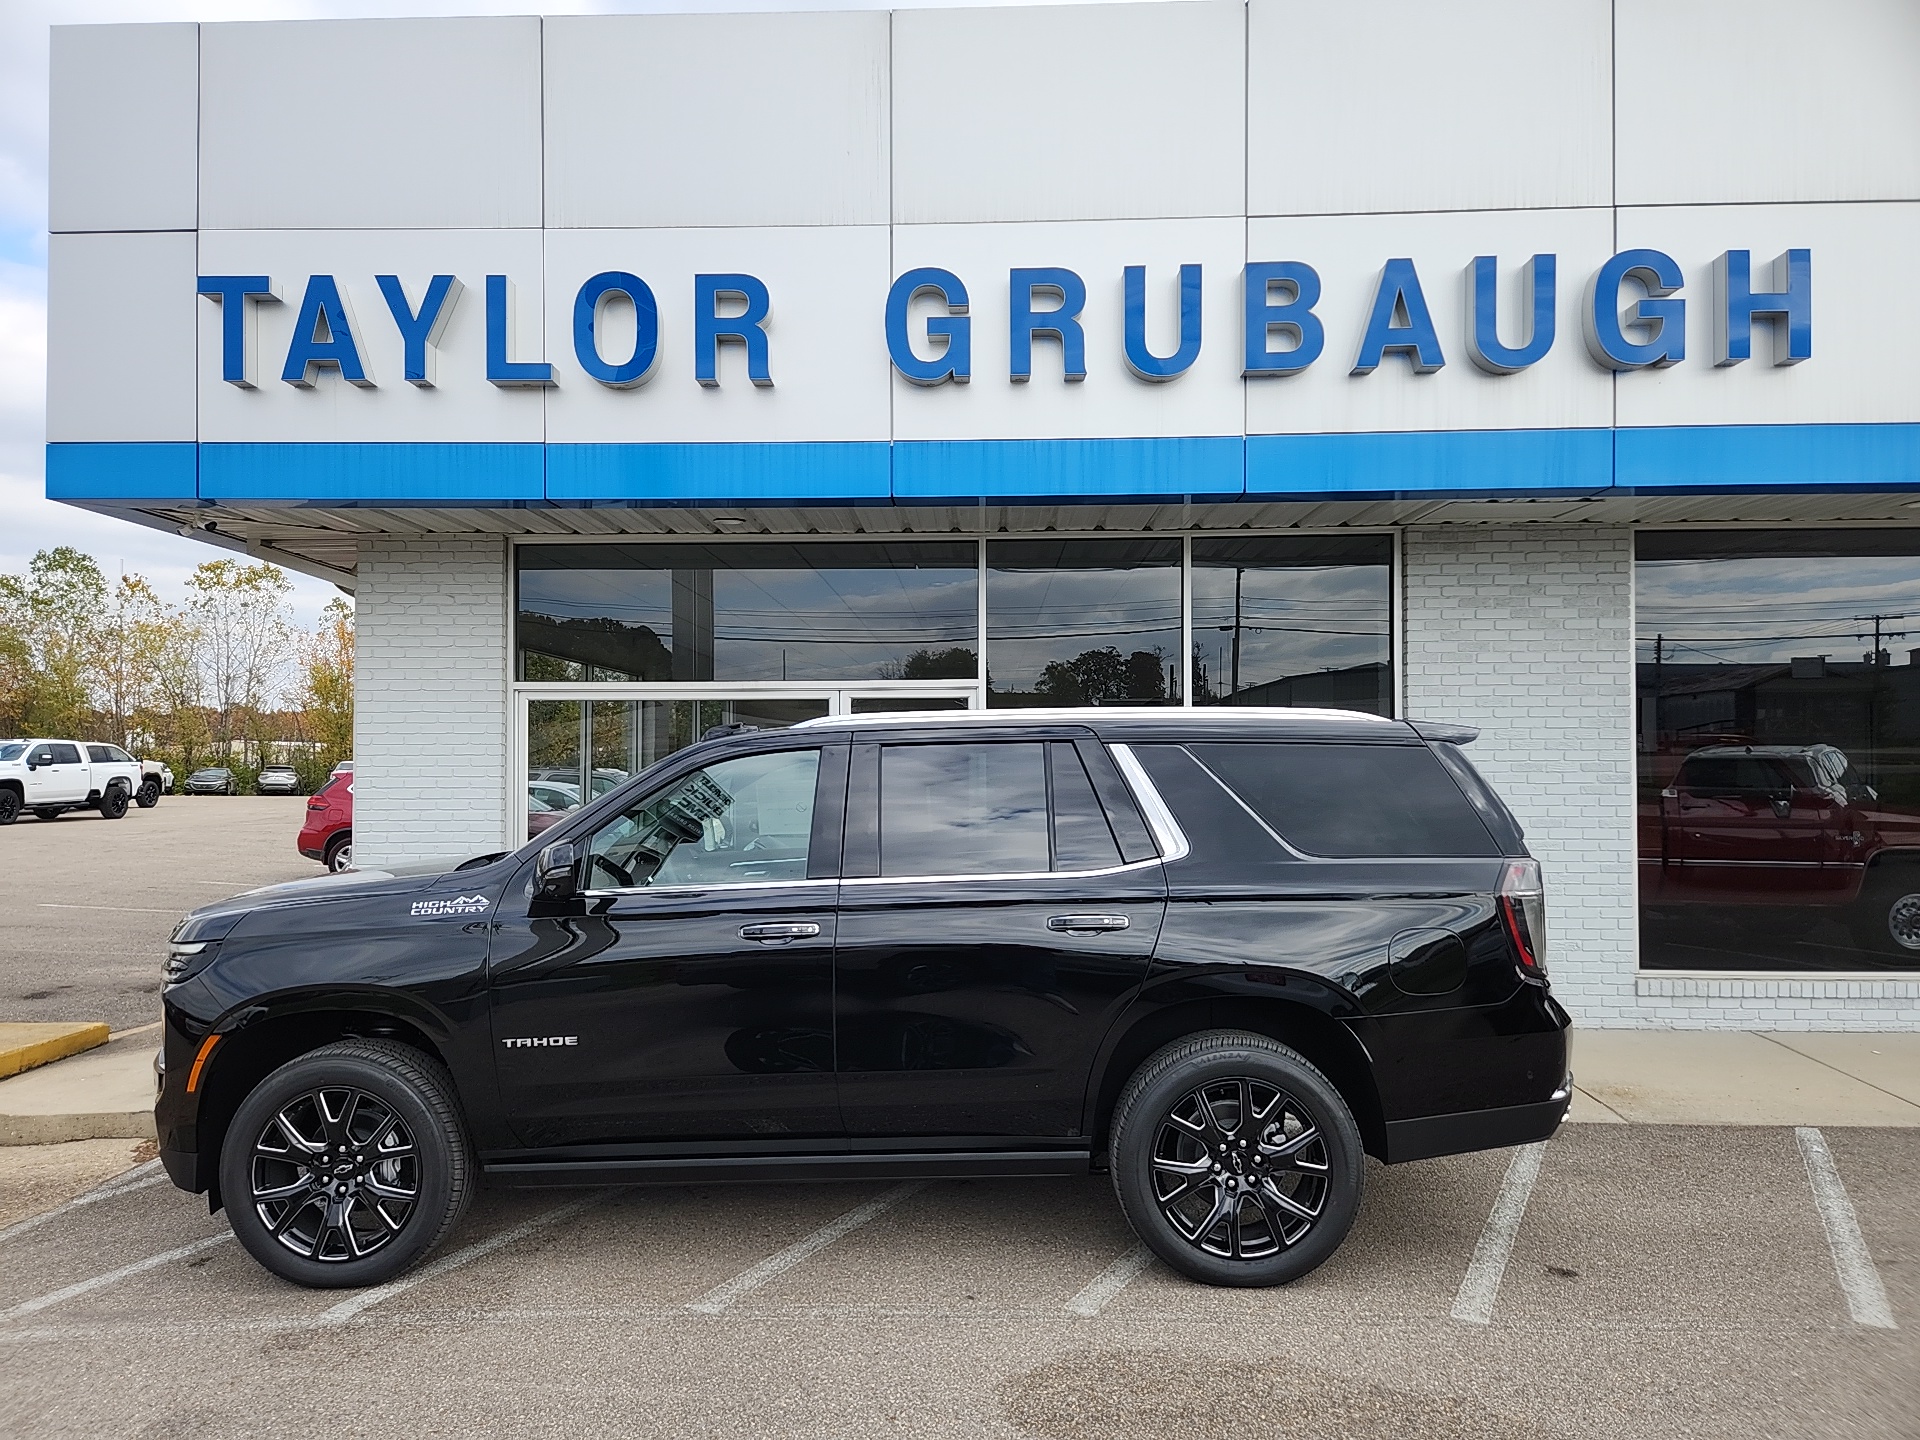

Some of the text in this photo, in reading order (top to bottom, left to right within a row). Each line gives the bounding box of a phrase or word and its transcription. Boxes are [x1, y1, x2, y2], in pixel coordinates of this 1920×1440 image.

[197, 248, 1813, 388] TAYLOR GRUBAUGH
[412, 900, 451, 909] HIGH
[410, 905, 489, 916] COUNTRY
[502, 1036, 579, 1048] TAHOE
